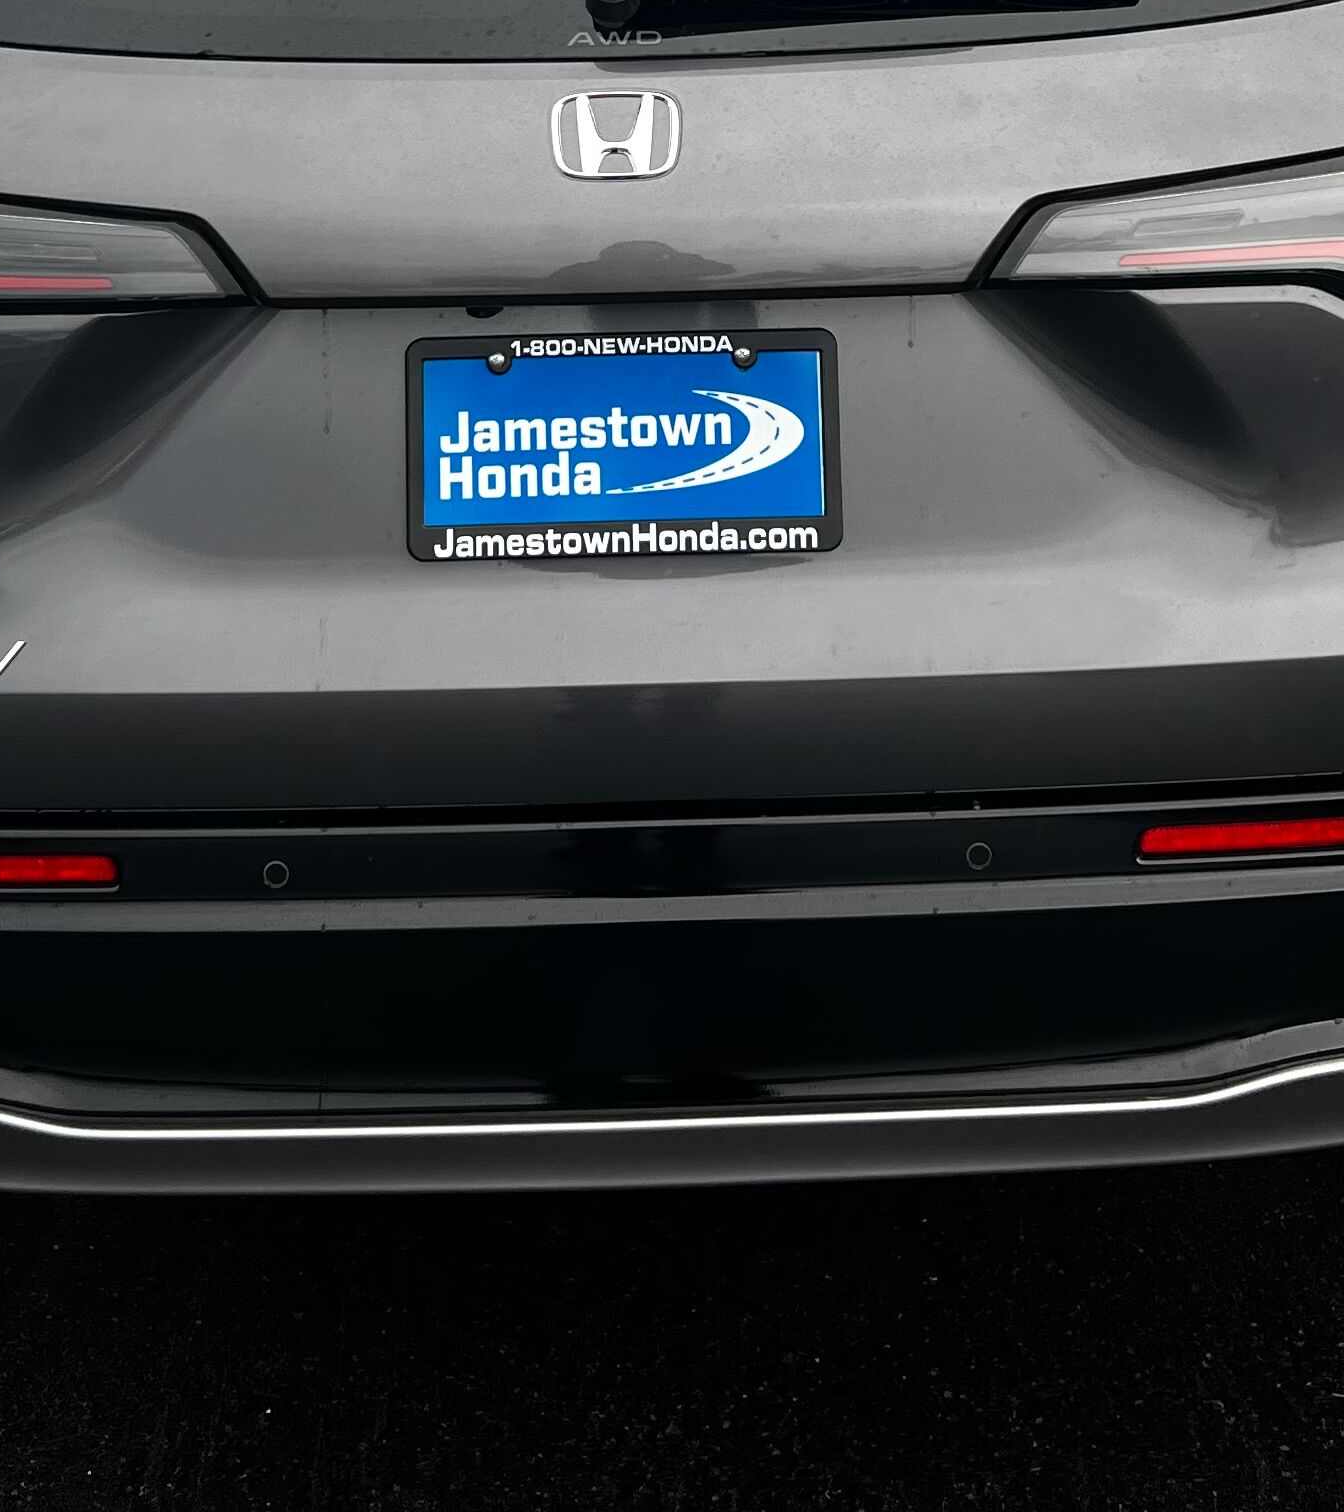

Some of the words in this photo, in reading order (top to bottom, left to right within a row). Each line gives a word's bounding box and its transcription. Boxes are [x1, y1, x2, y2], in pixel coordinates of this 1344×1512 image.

[567, 30, 663, 48] AWD
[510, 335, 734, 358] 1-800-NEW-HONDA
[439, 407, 733, 455] Jamestown
[439, 451, 602, 501] Honda
[433, 522, 819, 559] JamestownHonda.com
